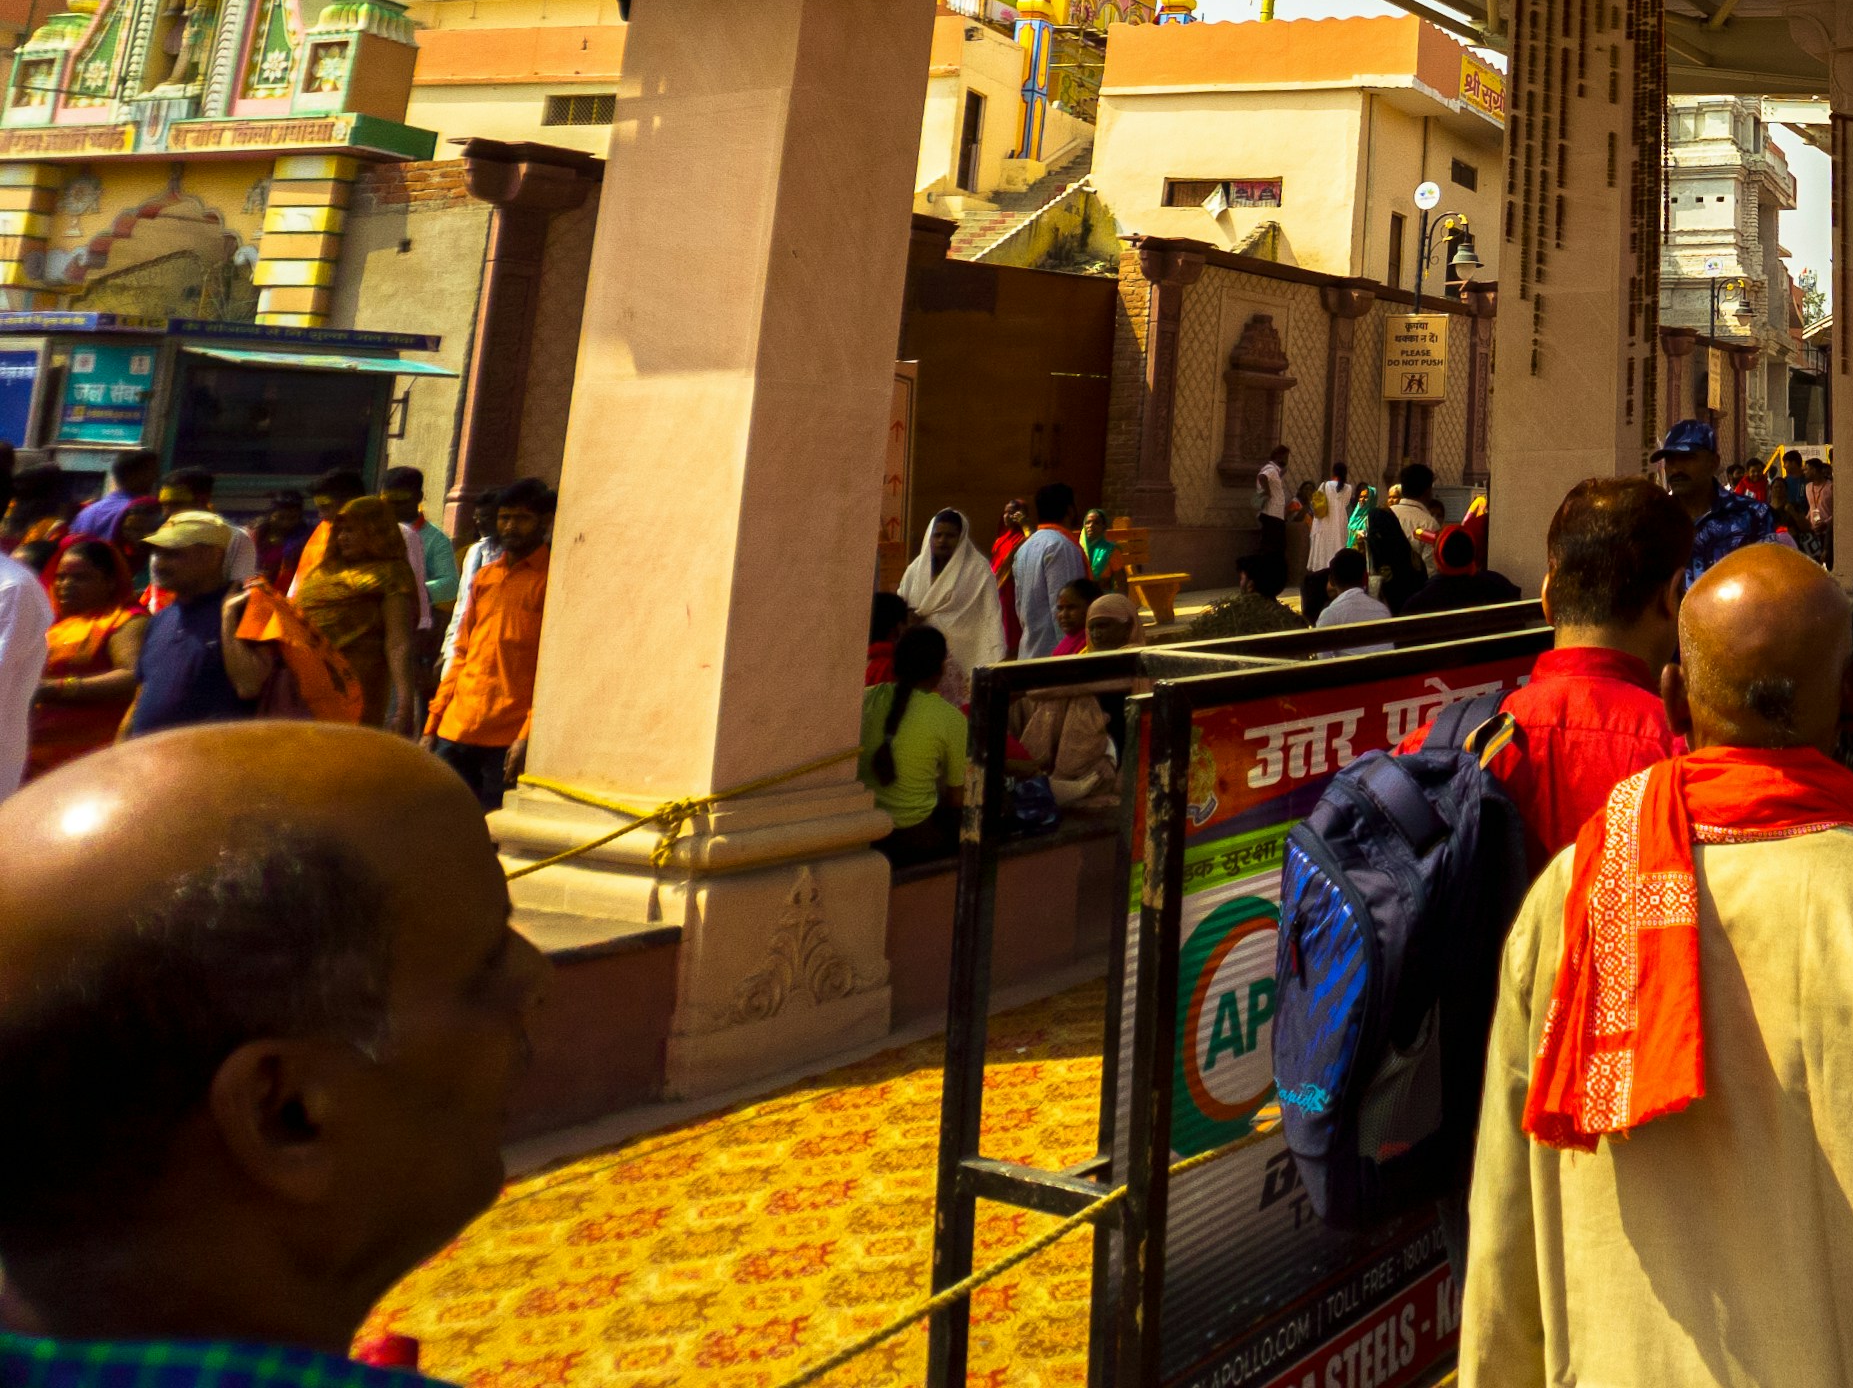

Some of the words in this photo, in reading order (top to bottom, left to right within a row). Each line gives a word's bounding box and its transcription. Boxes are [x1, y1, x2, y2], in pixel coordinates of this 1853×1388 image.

[1405, 322, 1428, 332] कृपया
[1420, 335, 1427, 343] न
[1387, 359, 1399, 367] DO
[1401, 359, 1418, 367] NOT
[1420, 359, 1443, 367] PUSH
[1244, 707, 1365, 789] उत्तर
